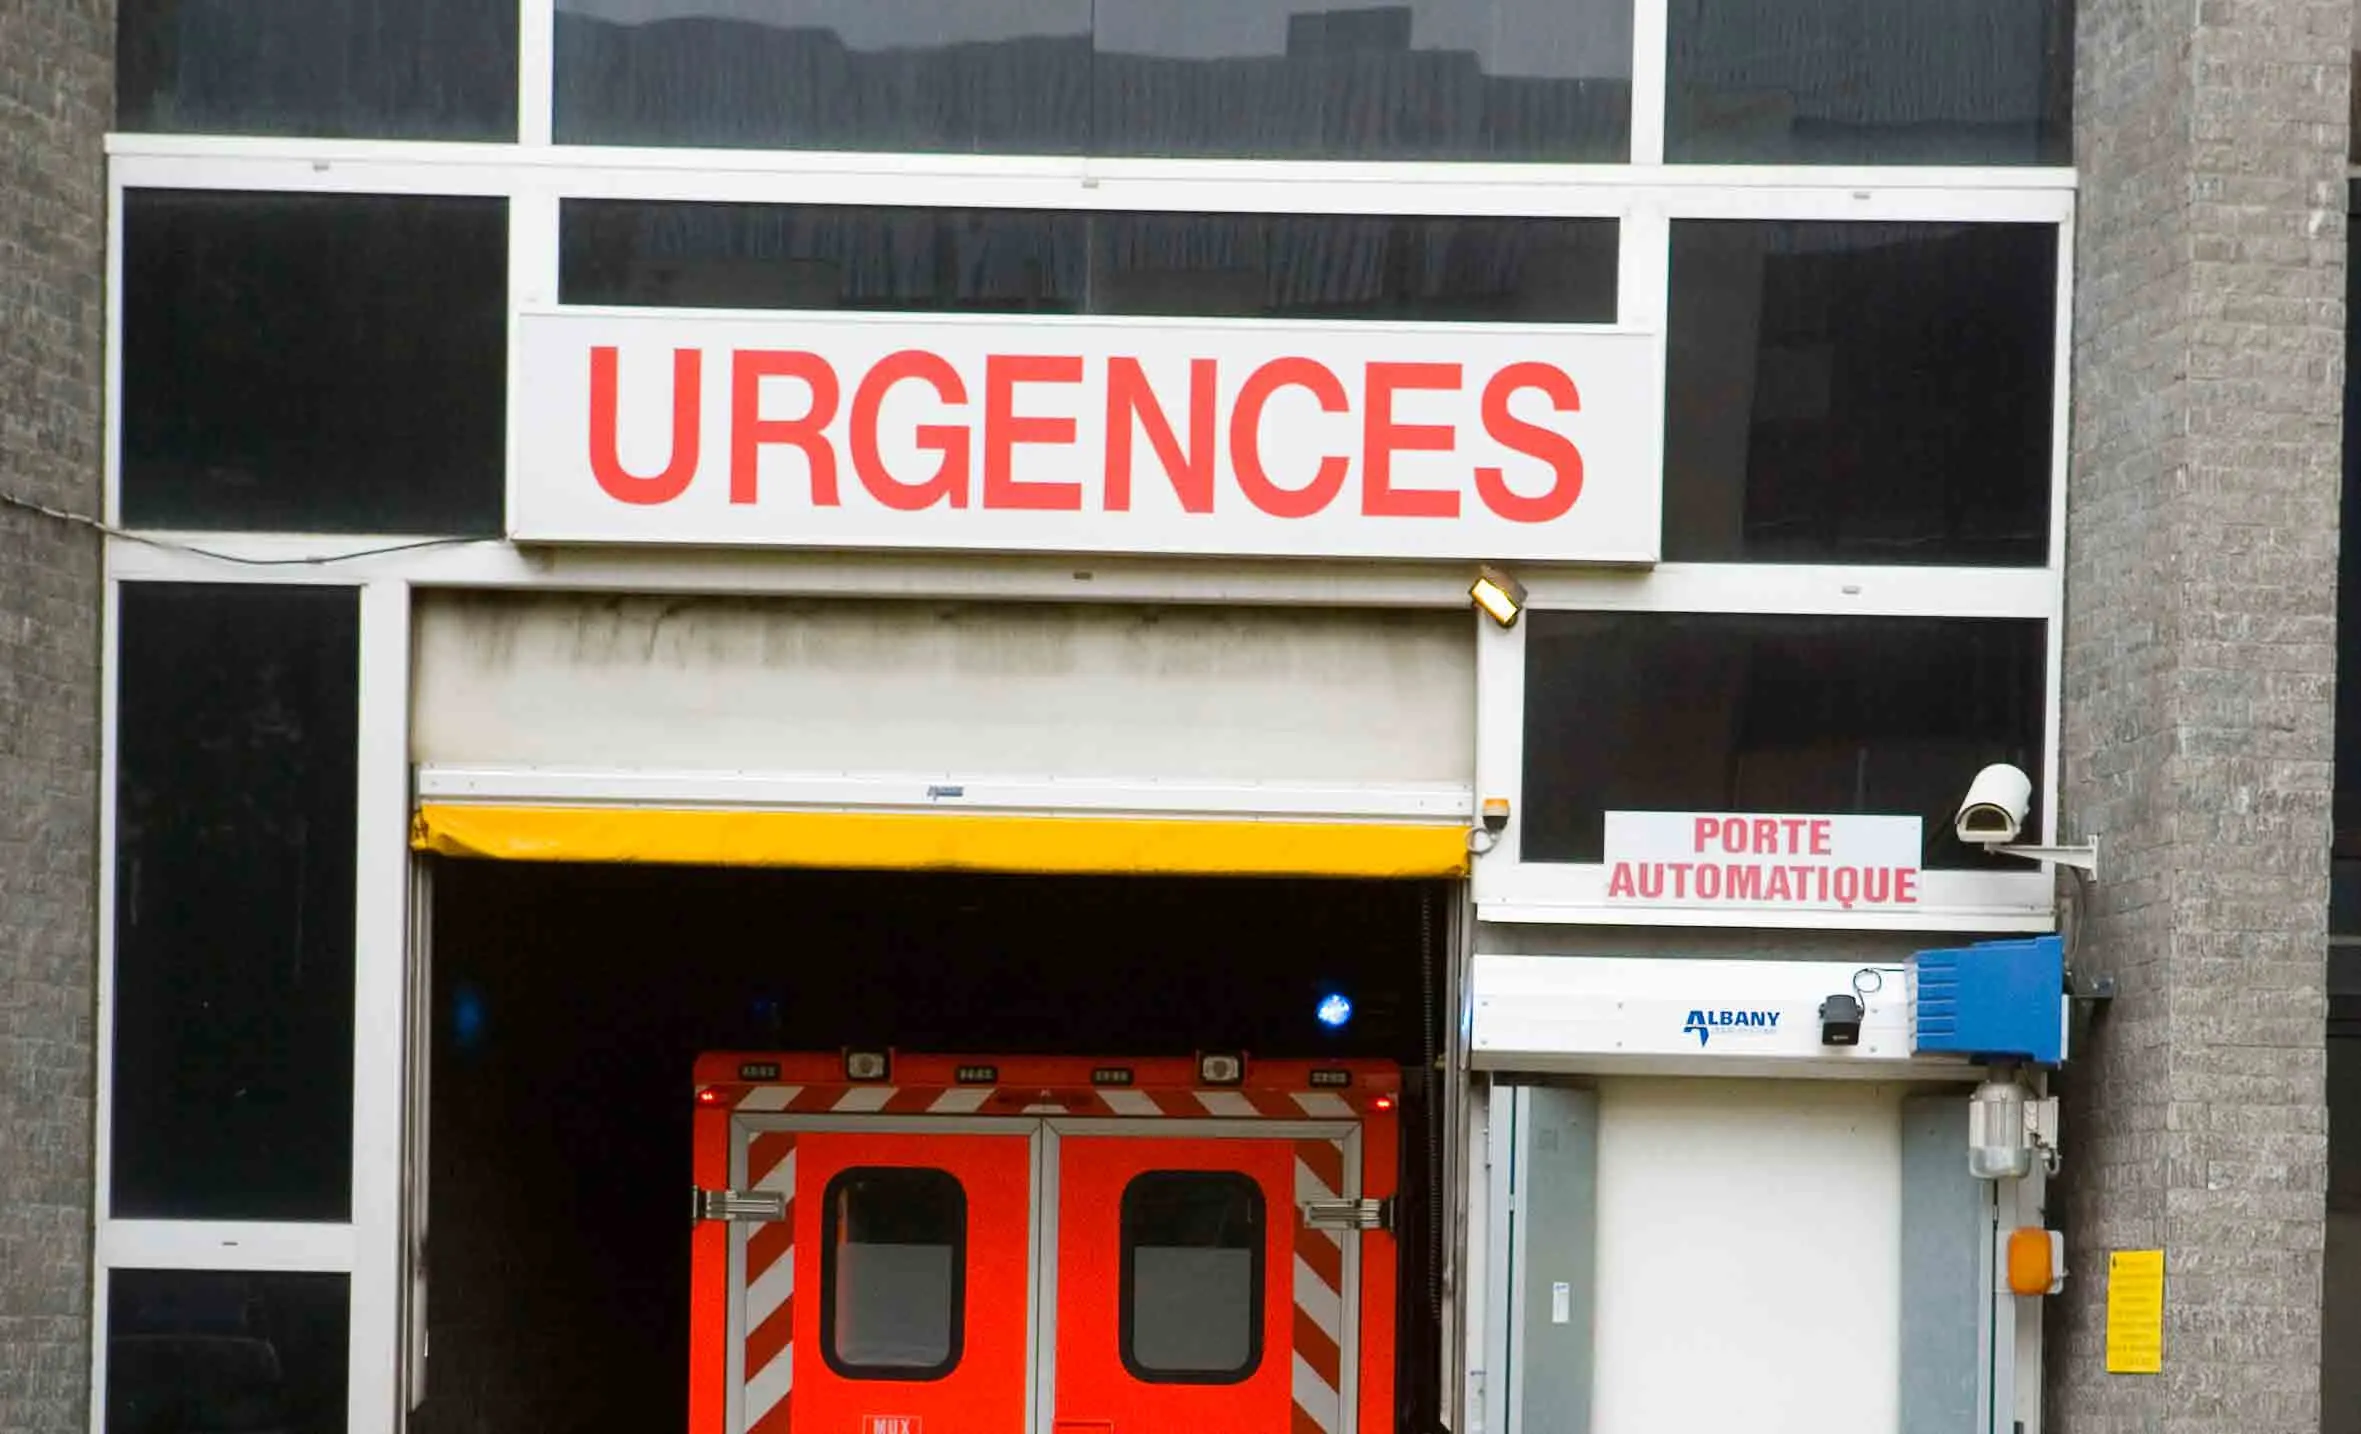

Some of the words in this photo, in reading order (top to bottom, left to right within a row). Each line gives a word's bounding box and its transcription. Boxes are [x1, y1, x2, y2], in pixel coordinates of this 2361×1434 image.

[588, 345, 1585, 525] URGENCES
[1694, 817, 1832, 855] PORTE
[1607, 862, 1918, 909] AUTOMATIQUE
